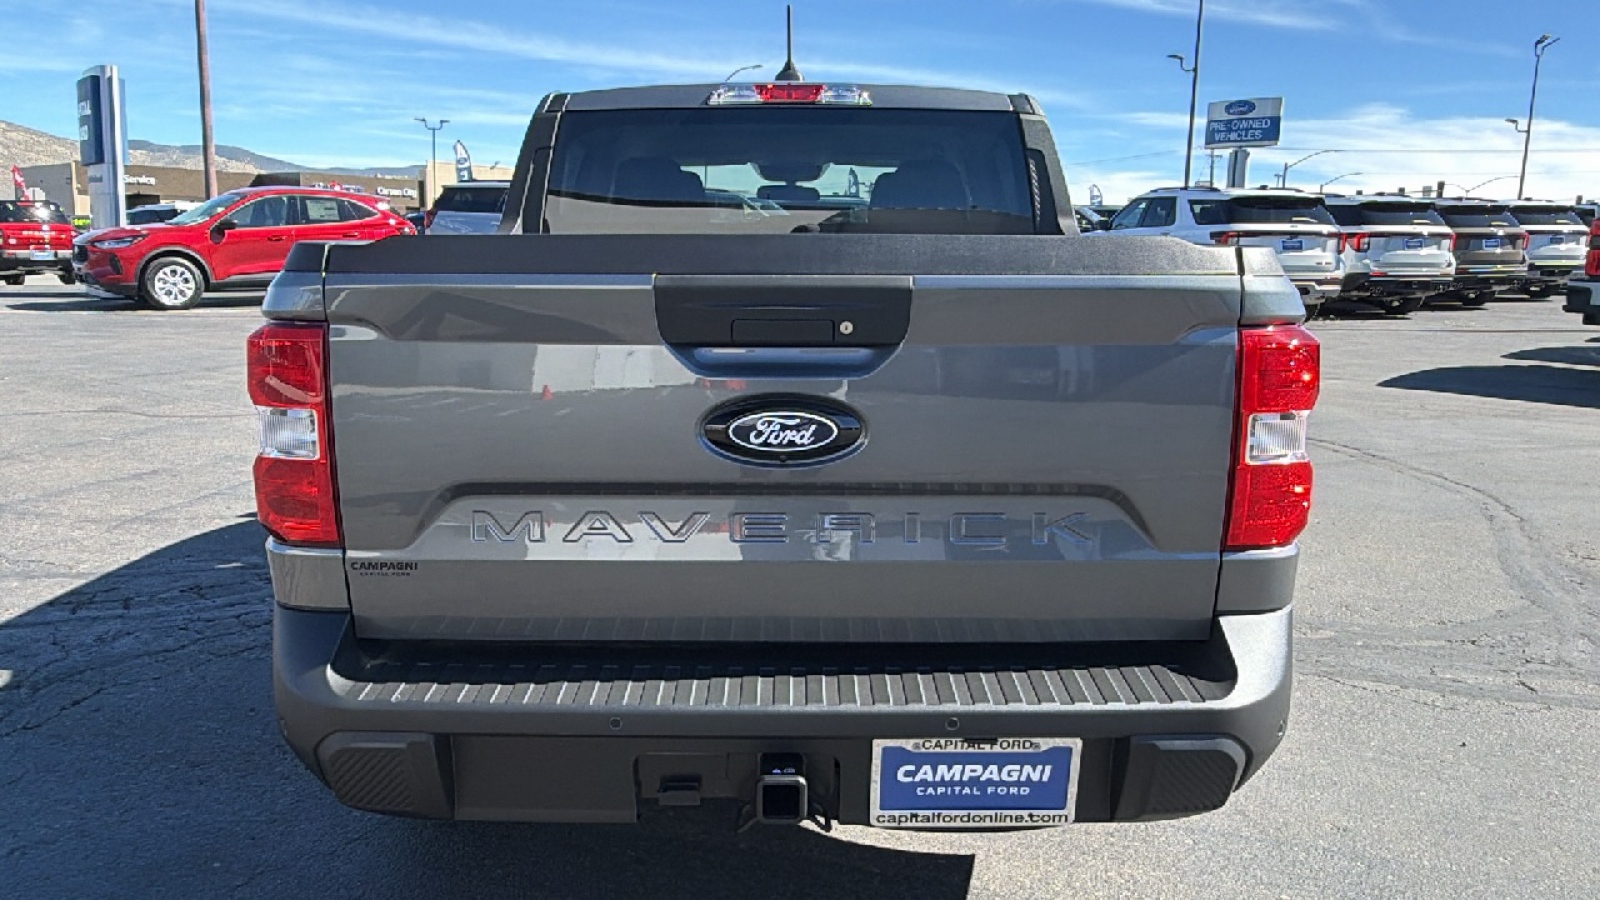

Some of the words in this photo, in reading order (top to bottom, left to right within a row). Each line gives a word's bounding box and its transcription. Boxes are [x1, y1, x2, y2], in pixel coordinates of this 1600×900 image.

[1215, 130, 1262, 140] VEHICLES
[750, 418, 817, 445] Ford
[469, 509, 1096, 546] MAVERICK
[351, 561, 418, 570] CAMPAGNI
[897, 765, 1052, 782] CAMPAGNI
[916, 786, 981, 796] CAPITAL
[987, 786, 1031, 796] FORD
[876, 812, 1068, 825] capitalfordonline.com
